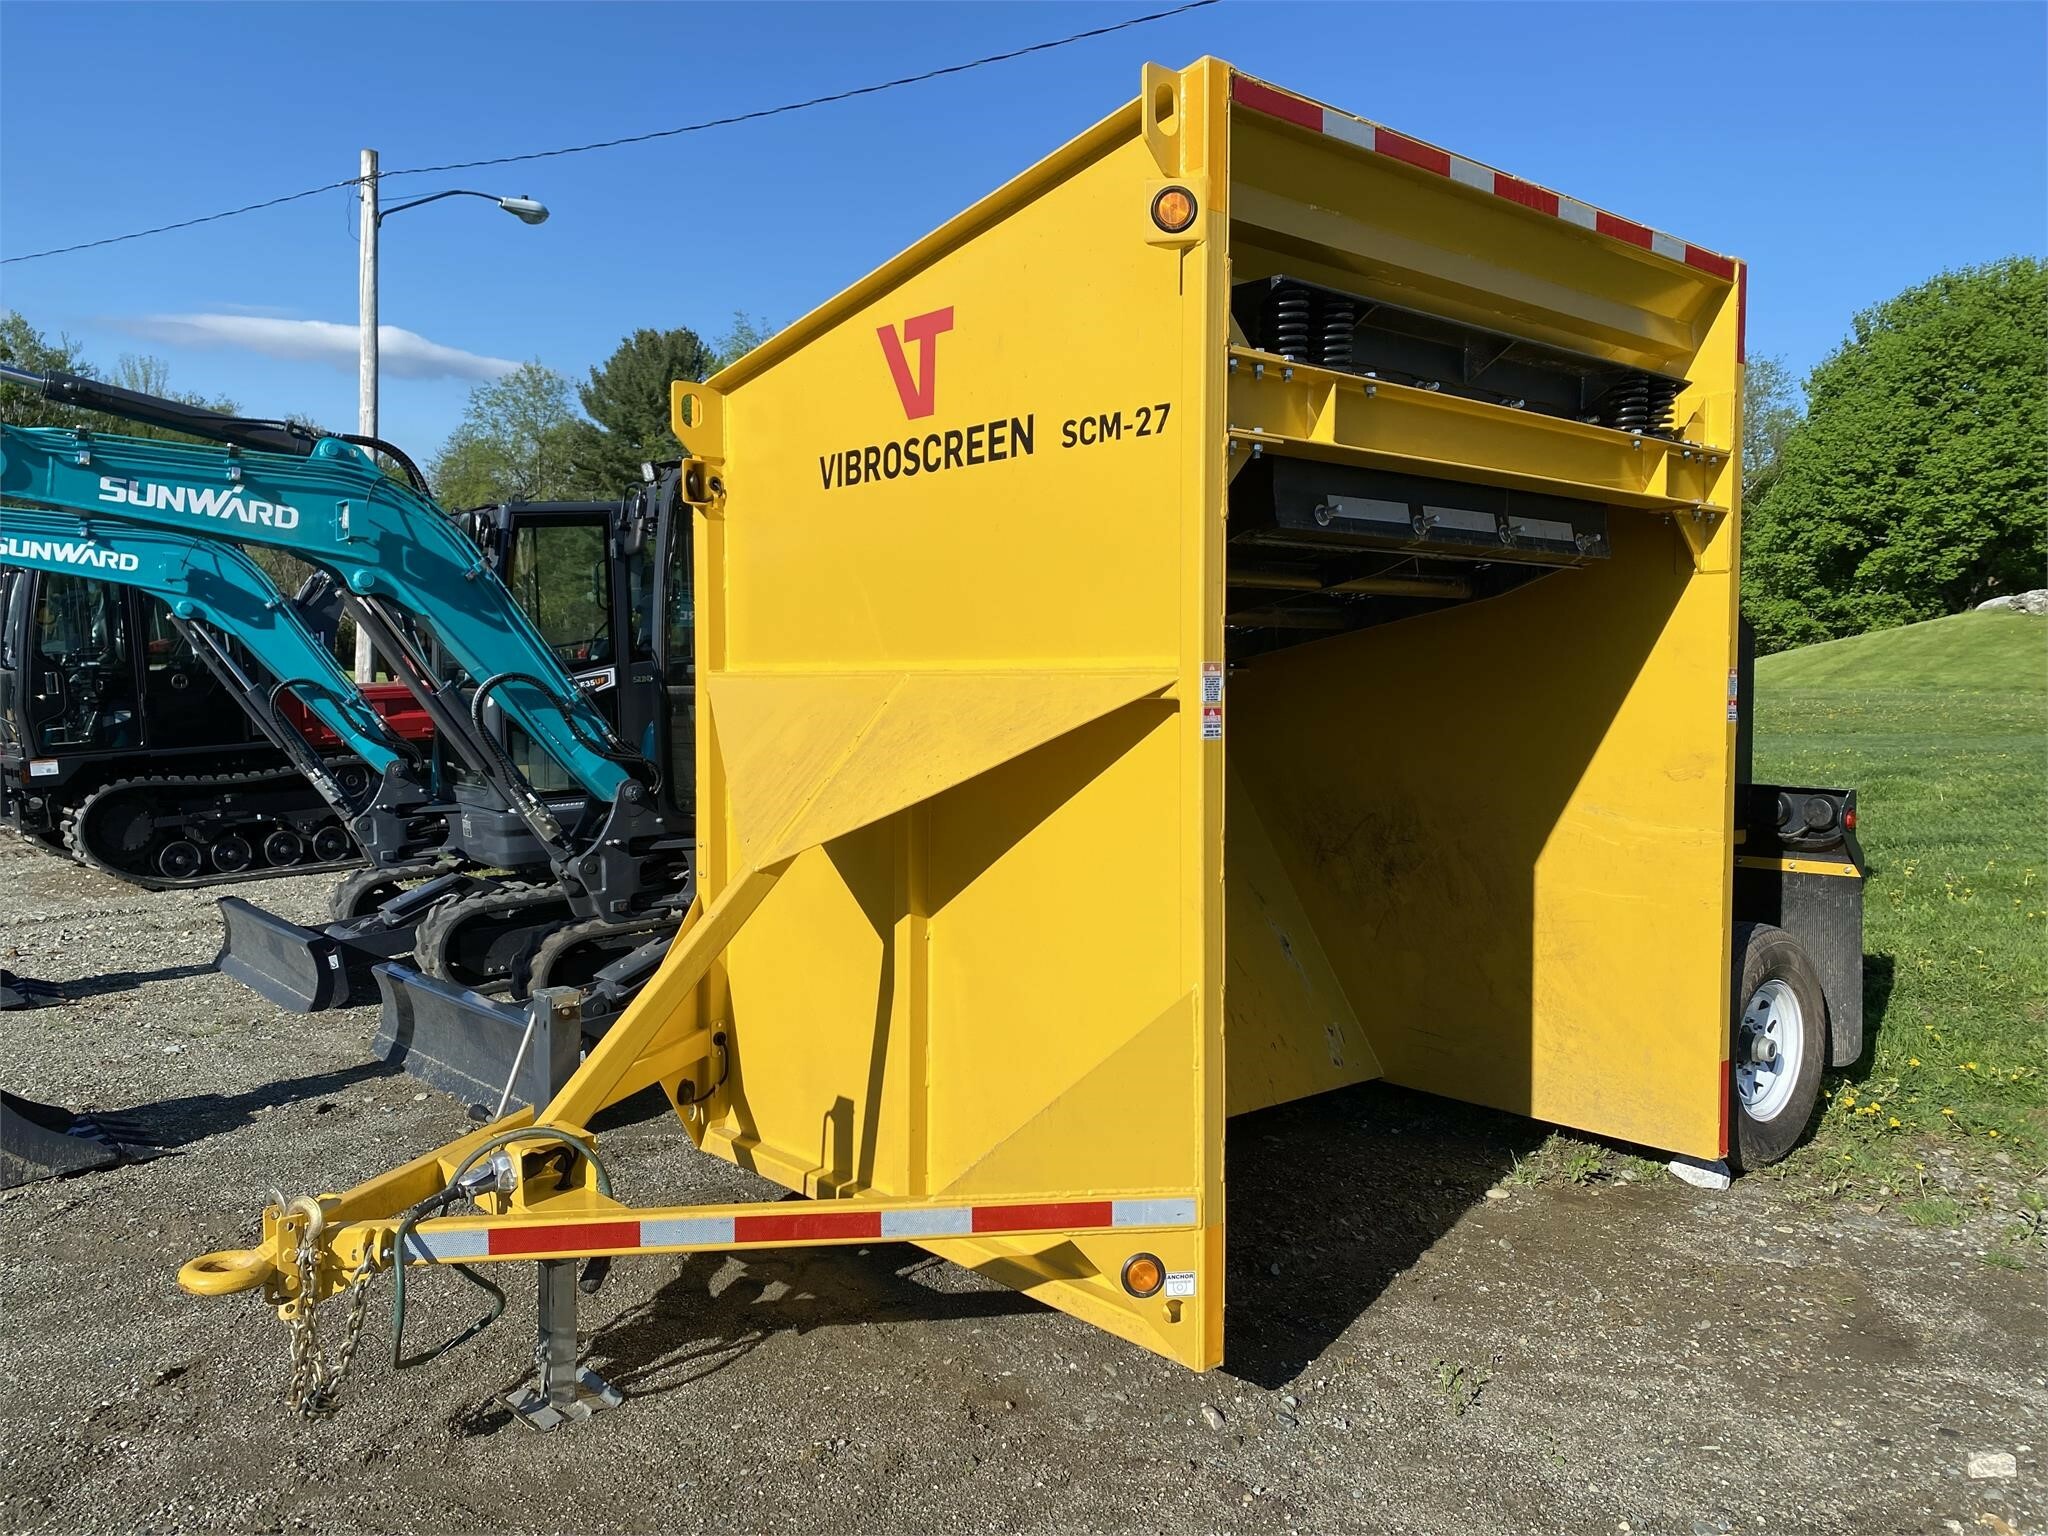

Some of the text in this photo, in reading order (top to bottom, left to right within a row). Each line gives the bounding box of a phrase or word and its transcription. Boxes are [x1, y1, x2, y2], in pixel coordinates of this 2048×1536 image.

[876, 305, 954, 421] VT
[819, 402, 1171, 490] VIBROSCREEN SCM-27
[99, 476, 299, 529] SUNWARD
[574, 676, 606, 689] E35UF
